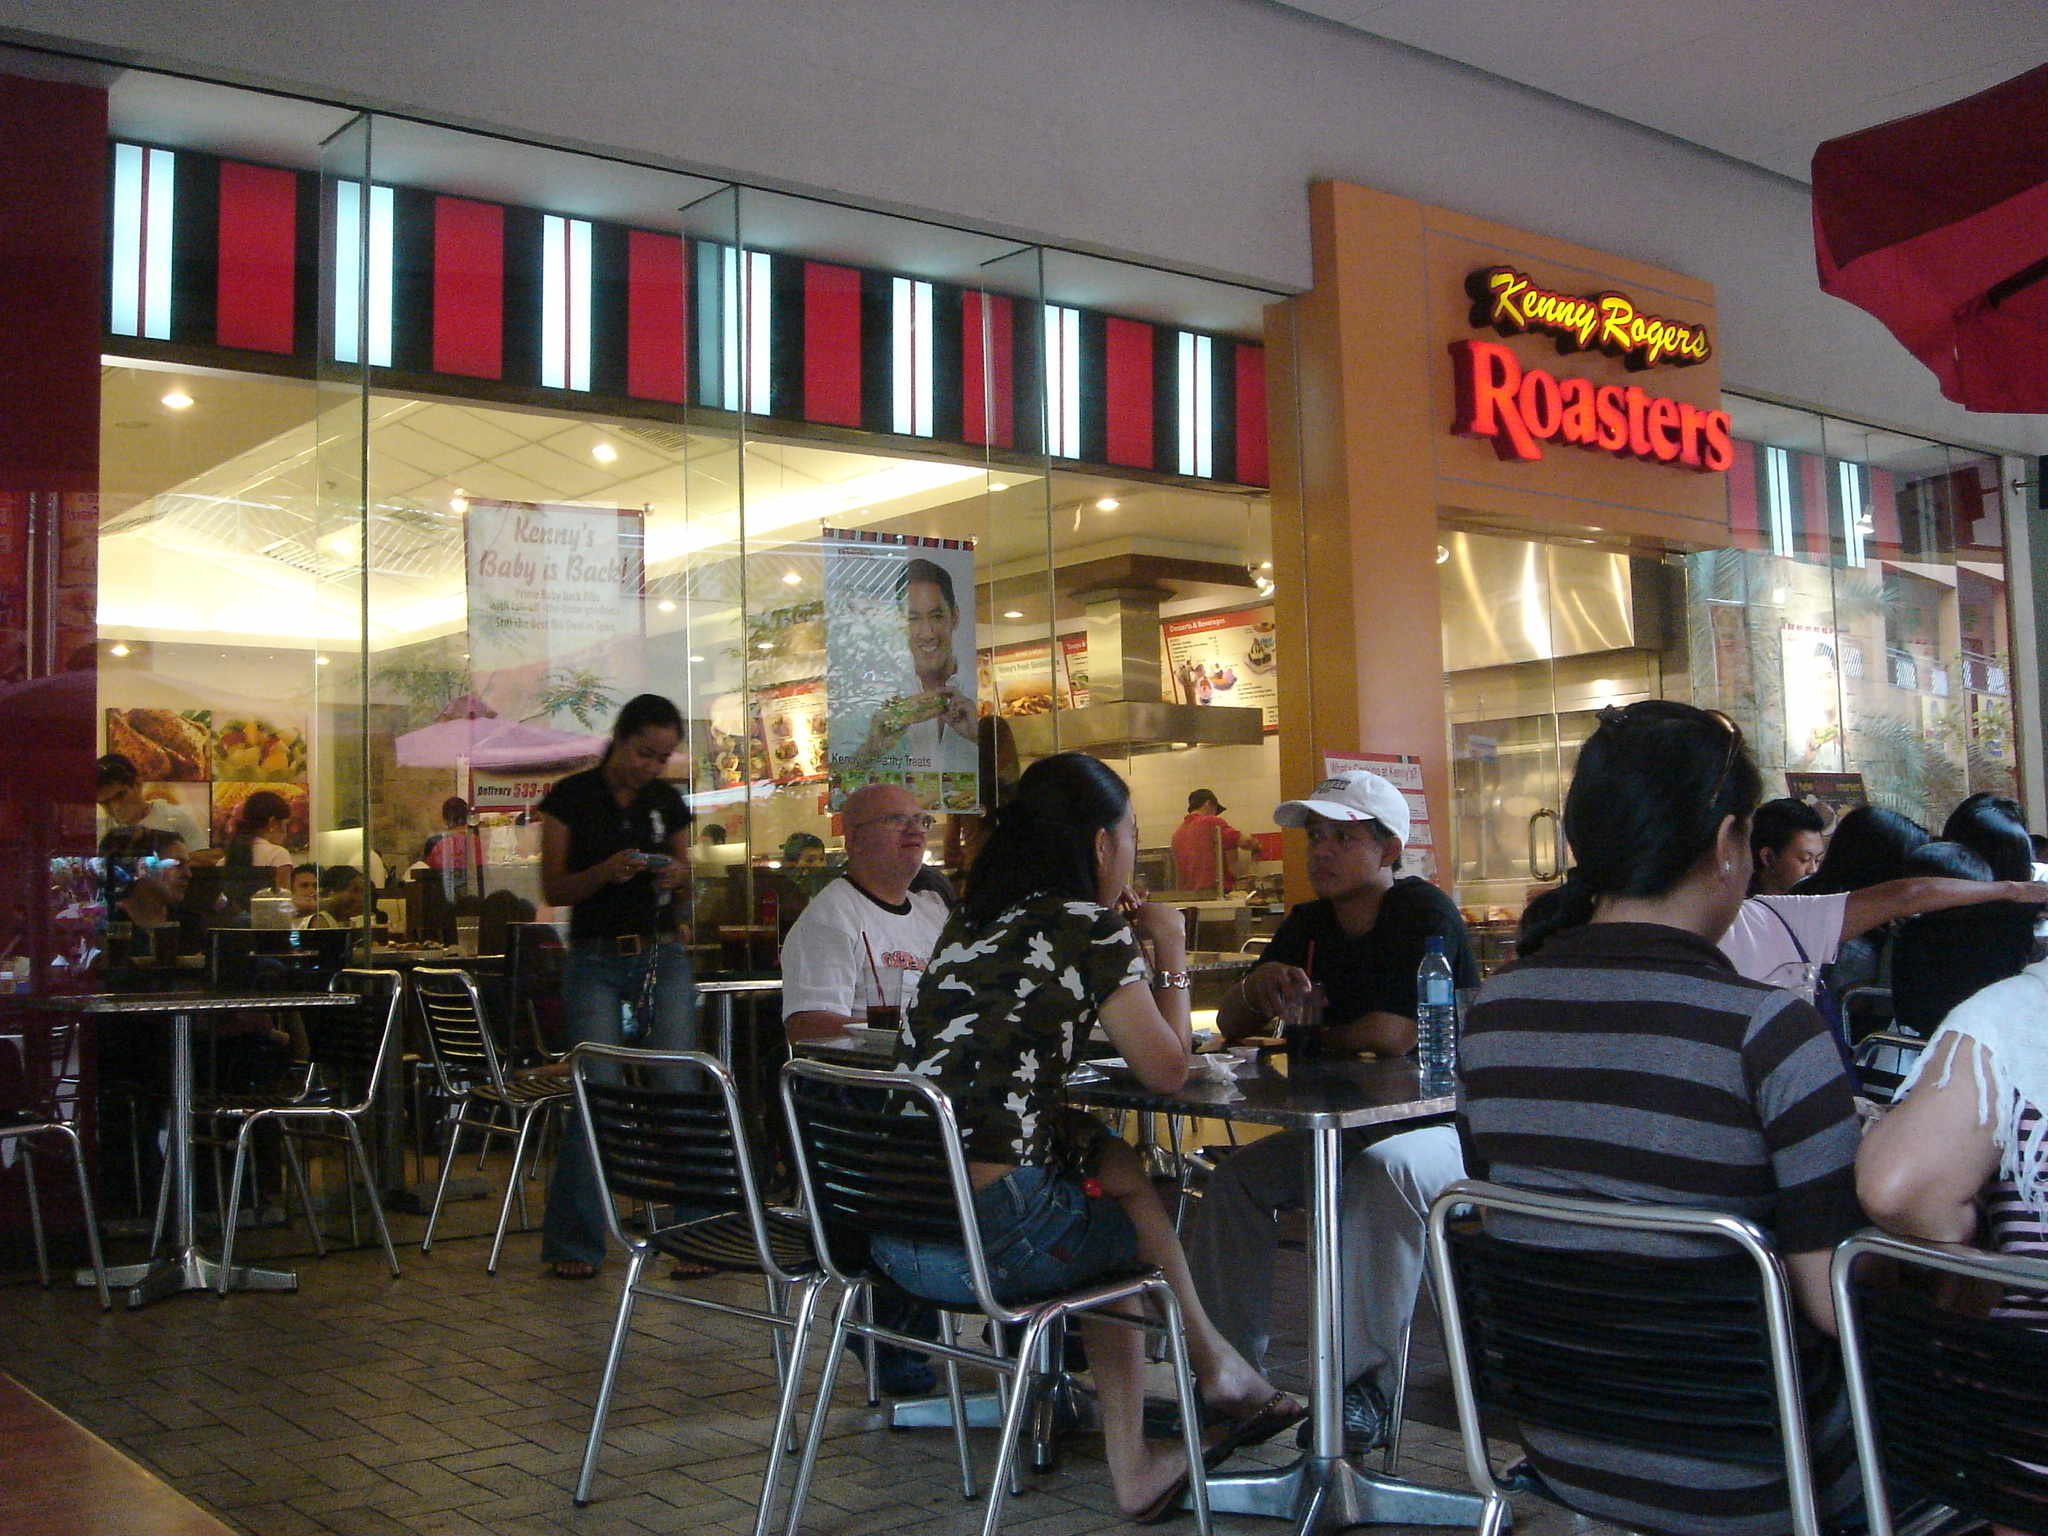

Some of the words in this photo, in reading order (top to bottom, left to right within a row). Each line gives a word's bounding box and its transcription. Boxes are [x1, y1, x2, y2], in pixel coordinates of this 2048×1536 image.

[1489, 272, 1598, 345] Kenny
[1600, 295, 1711, 363] Rogers
[1469, 339, 1735, 473] Roasters
[515, 516, 595, 549] Kenny's
[479, 551, 537, 586] Baby
[543, 556, 560, 581] is
